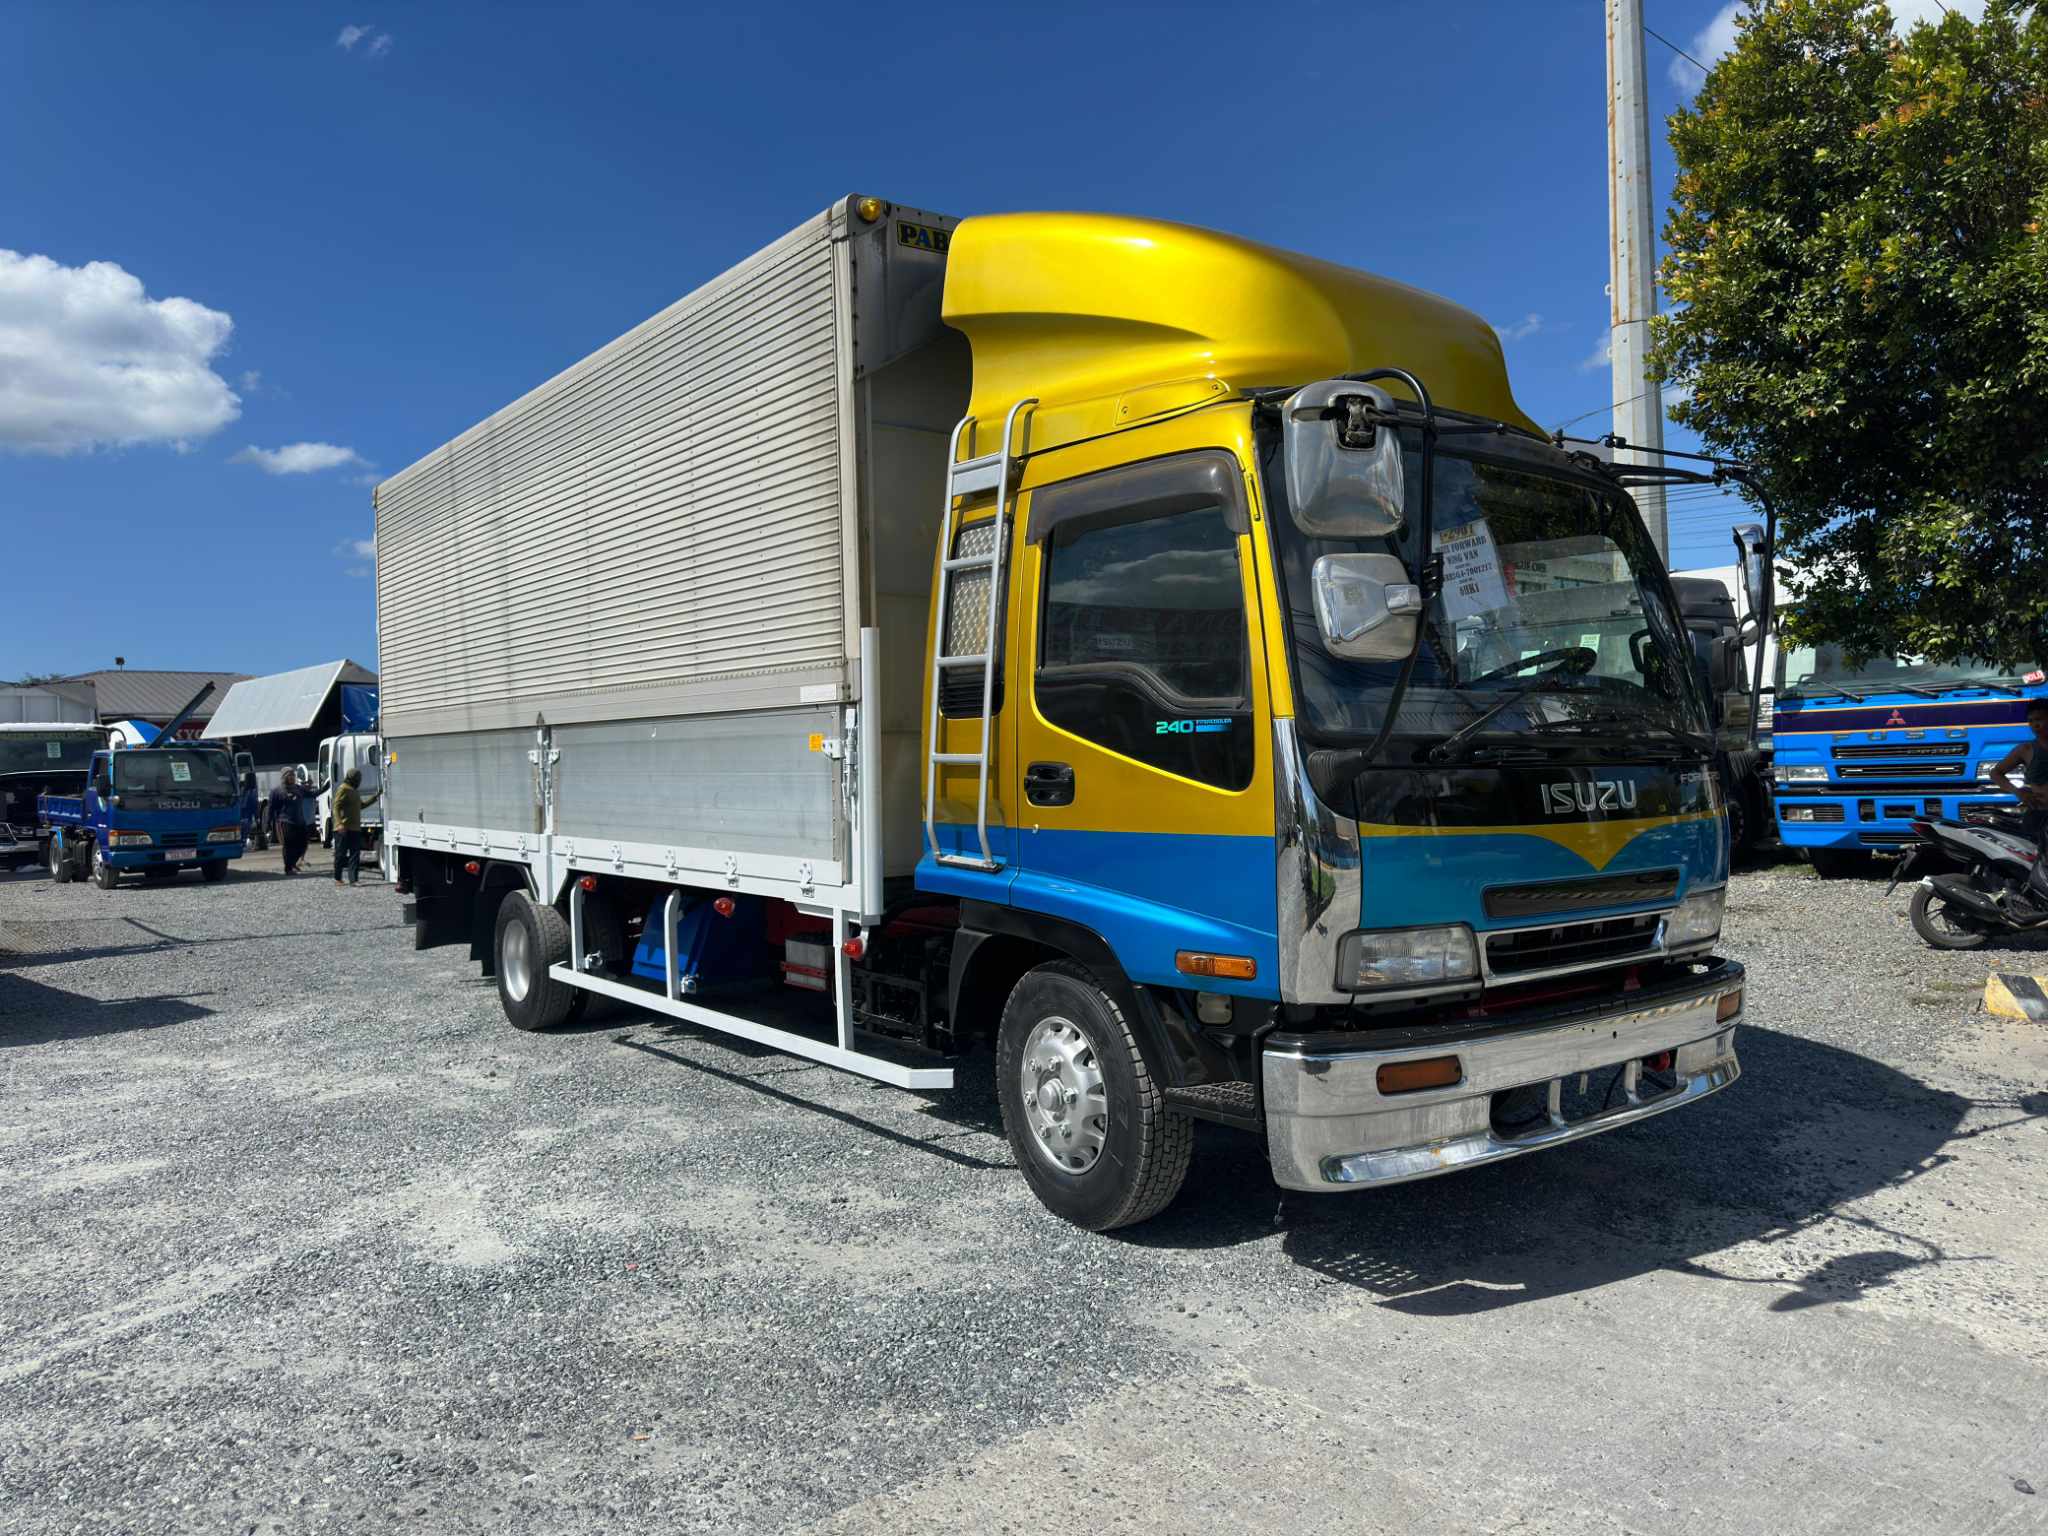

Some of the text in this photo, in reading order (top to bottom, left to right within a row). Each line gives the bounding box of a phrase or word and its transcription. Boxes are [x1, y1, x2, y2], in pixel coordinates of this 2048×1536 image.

[1463, 549, 1479, 561] VAN
[1155, 719, 1194, 735] 240
[1540, 779, 1638, 815] ISUZU
[158, 800, 201, 809] ISUZU
